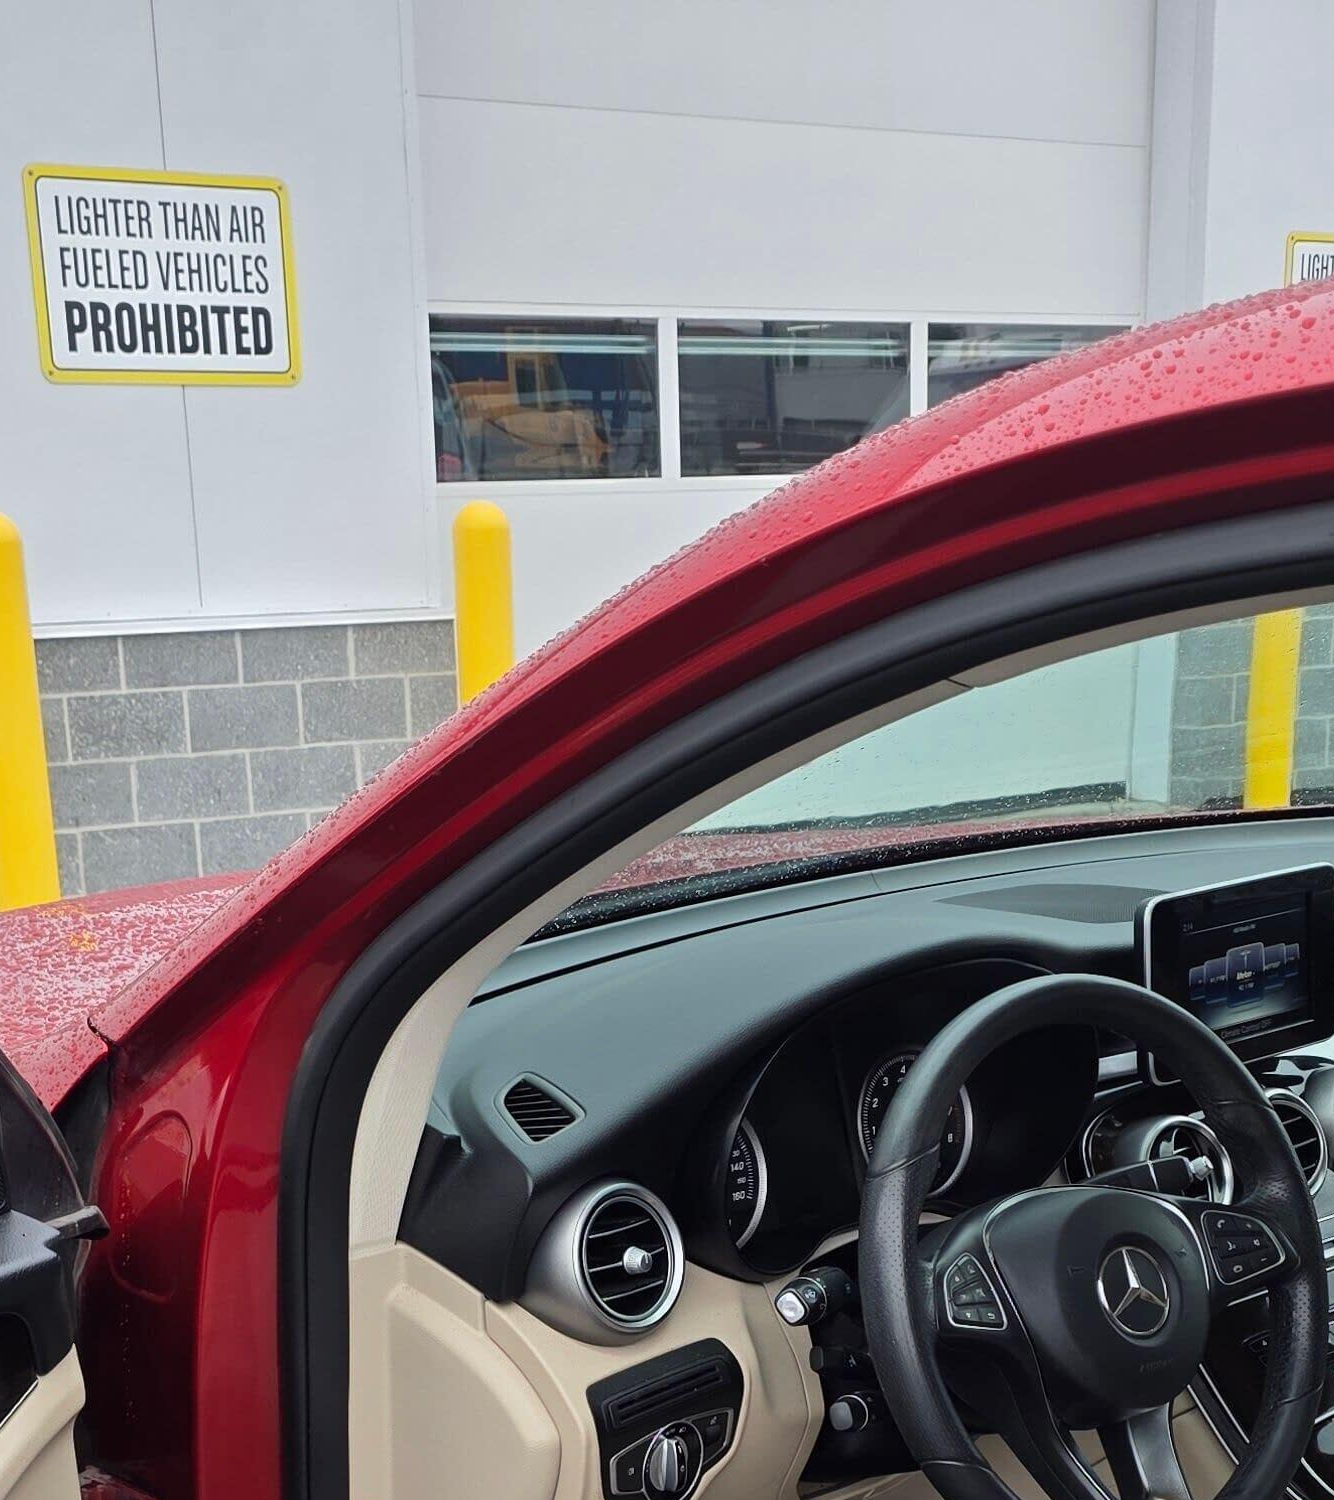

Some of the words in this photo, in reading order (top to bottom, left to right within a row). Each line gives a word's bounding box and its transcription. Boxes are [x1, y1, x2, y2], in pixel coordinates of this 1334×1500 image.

[54, 195, 153, 239] LIGHTER
[158, 201, 221, 242] THAN
[229, 205, 266, 244] AIR
[59, 246, 149, 290] FUELED
[155, 250, 269, 294] VEHICLES
[64, 300, 274, 356] PROHIBITED
[900, 1065, 906, 1074] 4
[882, 1076, 889, 1087] 3
[872, 1098, 879, 1108] 2
[730, 1161, 745, 1172] 140
[732, 1190, 746, 1201] 160
